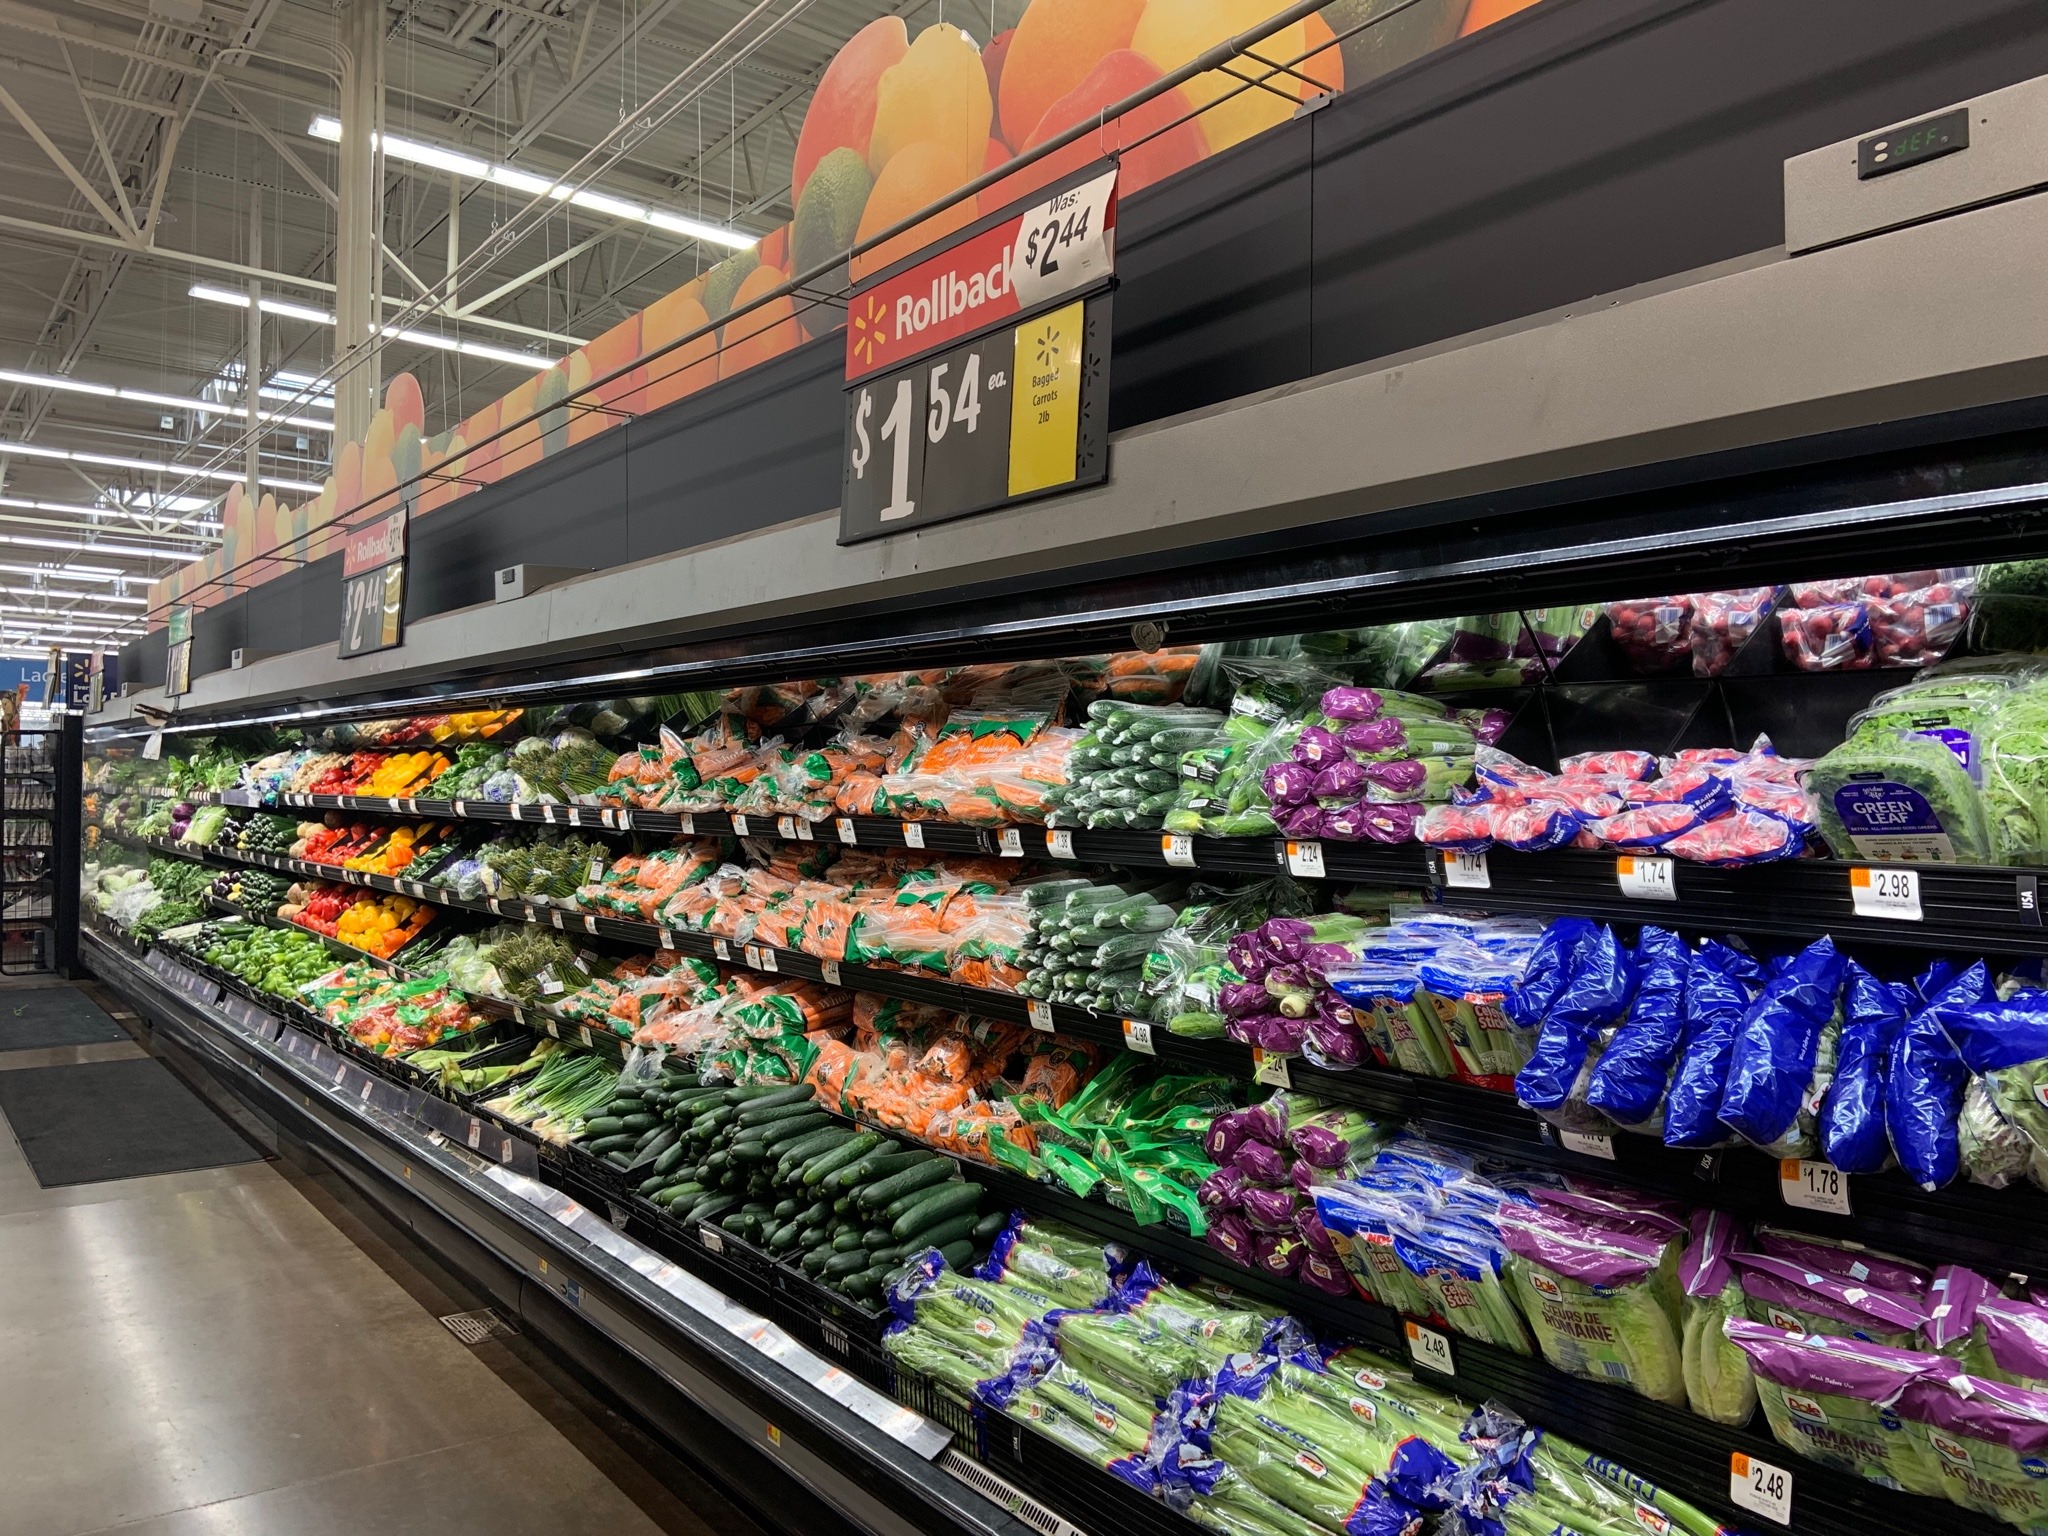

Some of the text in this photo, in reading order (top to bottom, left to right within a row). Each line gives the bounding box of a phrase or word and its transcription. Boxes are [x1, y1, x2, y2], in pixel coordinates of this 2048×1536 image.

[1048, 190, 1081, 216] Was:
[895, 245, 1014, 340] Rollback
[988, 370, 1006, 391] ea.
[1031, 368, 1060, 388] Bagged
[1032, 389, 1058, 407] Carrots
[1038, 410, 1050, 425] 2lb
[357, 529, 389, 563] Rollback
[1695, 783, 1722, 806] Radishes
[1698, 798, 1715, 813] frais
[1852, 801, 1914, 814] GREEN
[1865, 812, 1909, 824] LEAF
[2021, 891, 2034, 909] USA
[1540, 1122, 1548, 1136] USA
[1701, 1154, 1713, 1169] USA
[1534, 1276, 1558, 1294] Dole
[1542, 1311, 1615, 1343] ROMAINE
[1584, 1311, 1601, 1324] DE
[1774, 1314, 1802, 1334] Dole
[1809, 1373, 1824, 1381] Wash
[1825, 1378, 1842, 1387] Before
[1788, 1397, 1821, 1418] Dole
[1790, 1417, 1891, 1459] ROMAINE
[1935, 1438, 1969, 1461] Dole
[1941, 1460, 2046, 1510] ROMAINE
